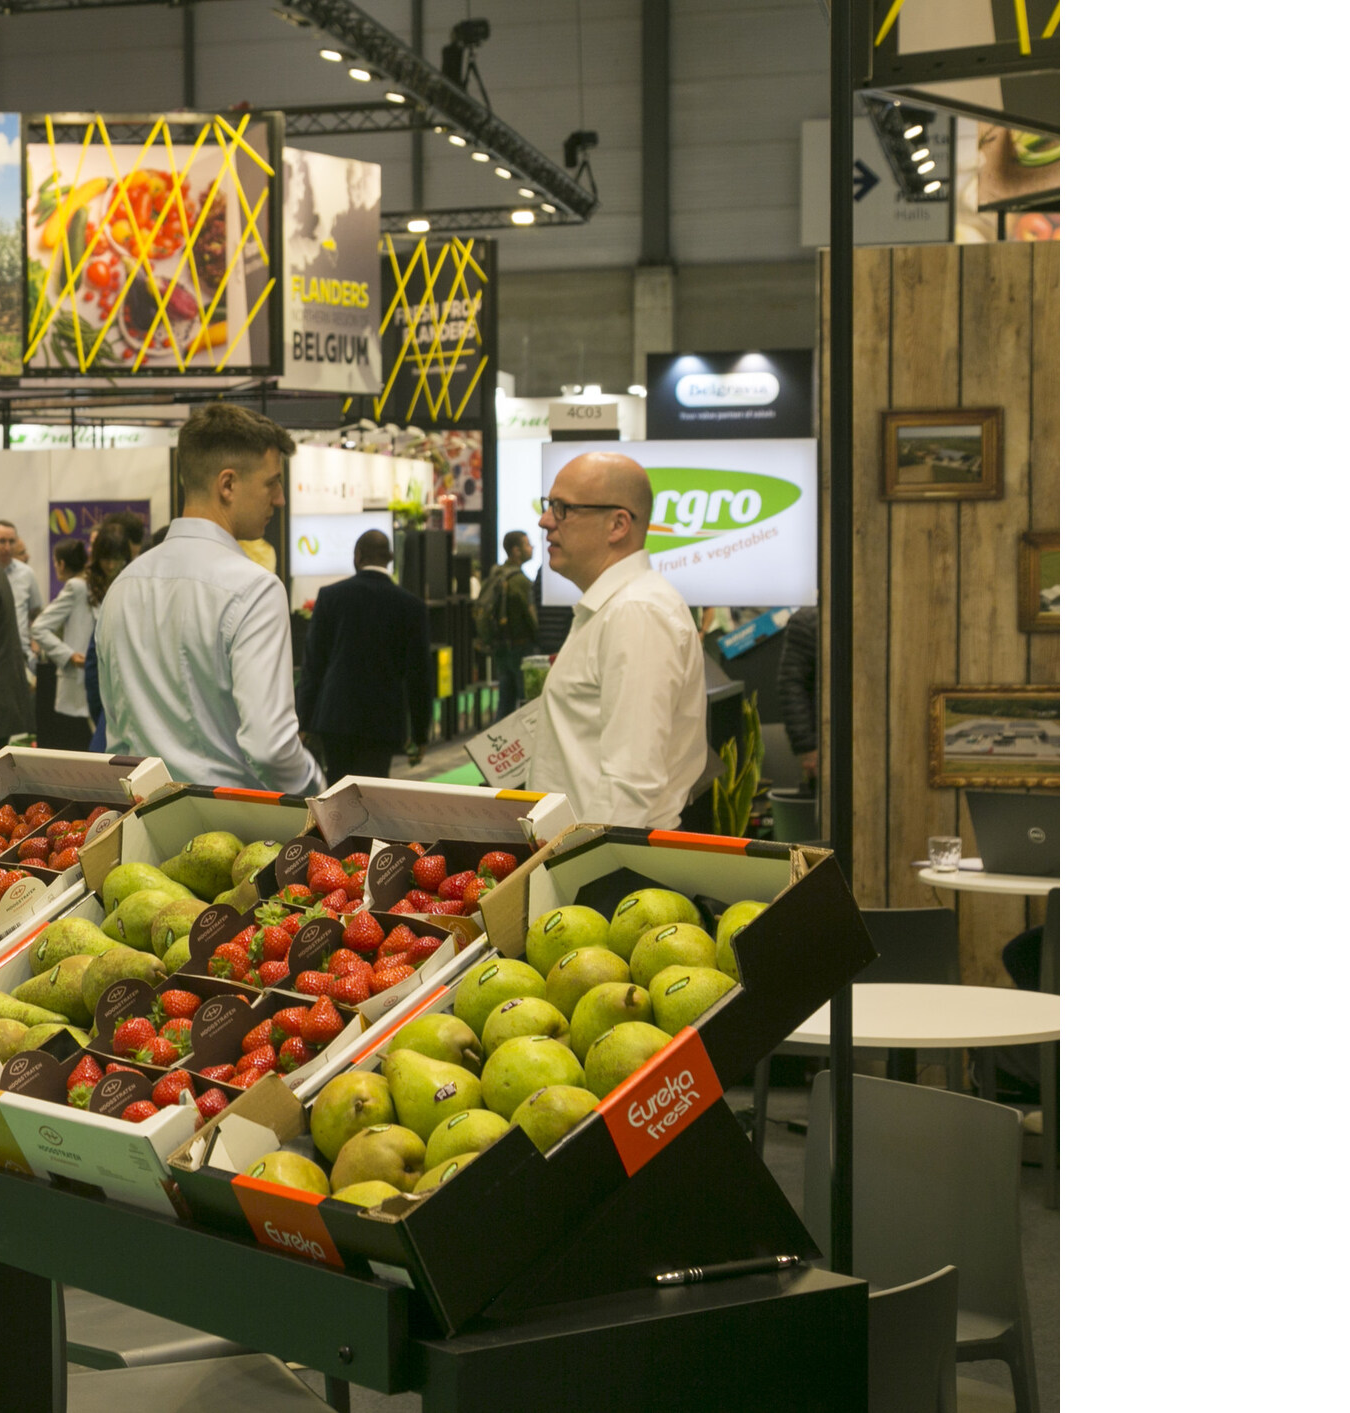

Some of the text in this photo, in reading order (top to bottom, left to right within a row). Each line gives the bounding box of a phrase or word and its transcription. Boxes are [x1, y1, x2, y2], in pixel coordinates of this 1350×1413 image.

[291, 274, 370, 310] FLANDERS
[292, 330, 370, 366] BELGIUM
[566, 405, 603, 420] 4C03
[651, 488, 763, 536] rgro
[657, 526, 779, 574] fruit & vegetables
[494, 760, 513, 774] en
[196, 913, 230, 942] HOOGSTRATEN
[297, 927, 333, 959] HOOGSTRATEN
[103, 988, 140, 1019] HOOGSTRATEN
[199, 1006, 237, 1039] HOOGSTRATEN
[7, 1062, 43, 1091] HOOGSTRATEN
[98, 1082, 137, 1114] HOOGSTRATEN
[627, 1069, 695, 1128] Eureka
[263, 1220, 327, 1260] Eureka
